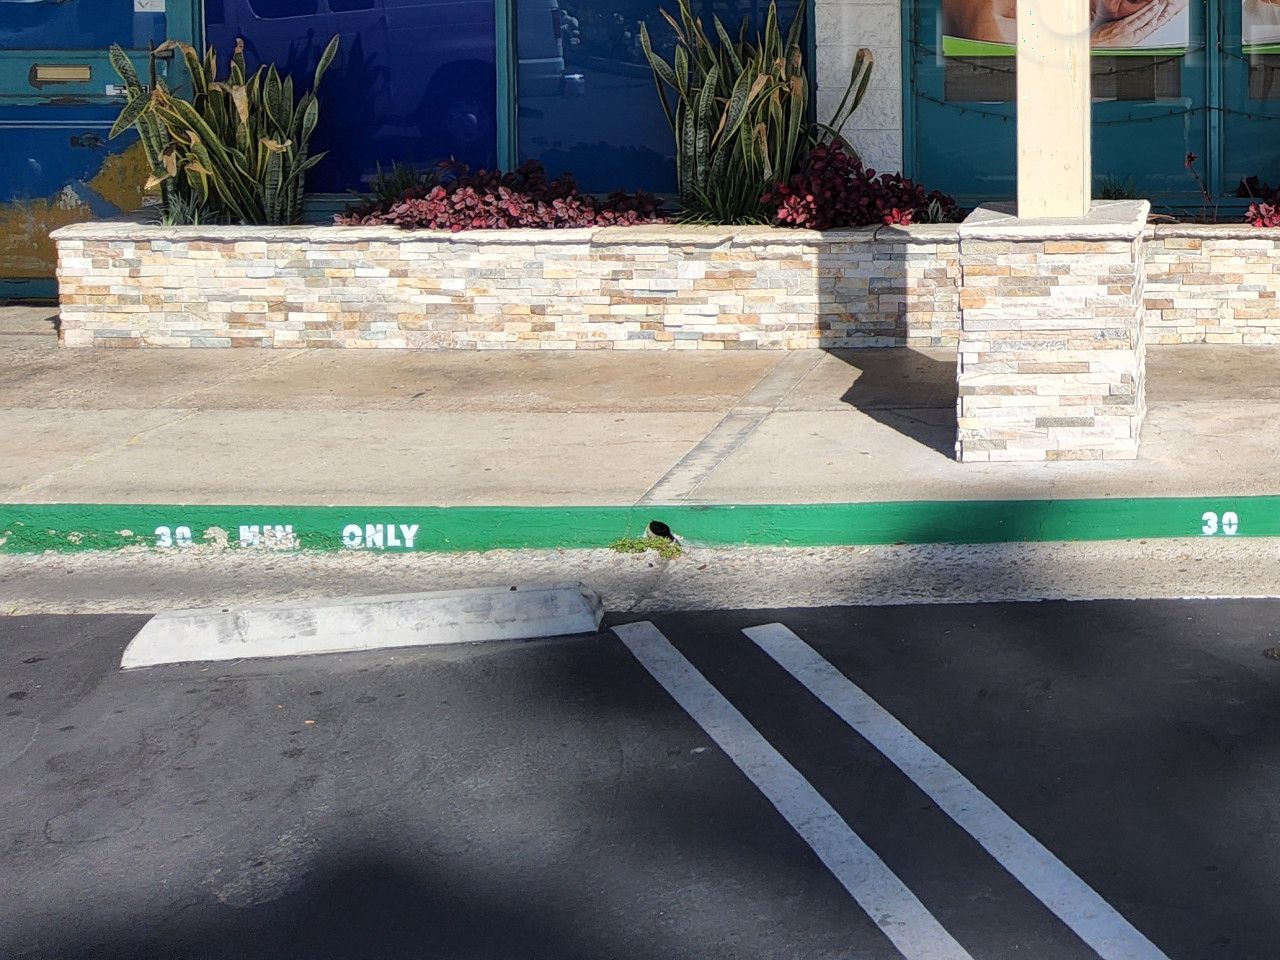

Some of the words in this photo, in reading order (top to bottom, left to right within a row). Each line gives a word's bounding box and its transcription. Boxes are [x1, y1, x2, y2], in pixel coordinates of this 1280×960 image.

[1201, 511, 1239, 535] 30
[154, 525, 193, 548] 30
[342, 523, 420, 549] ONLY
